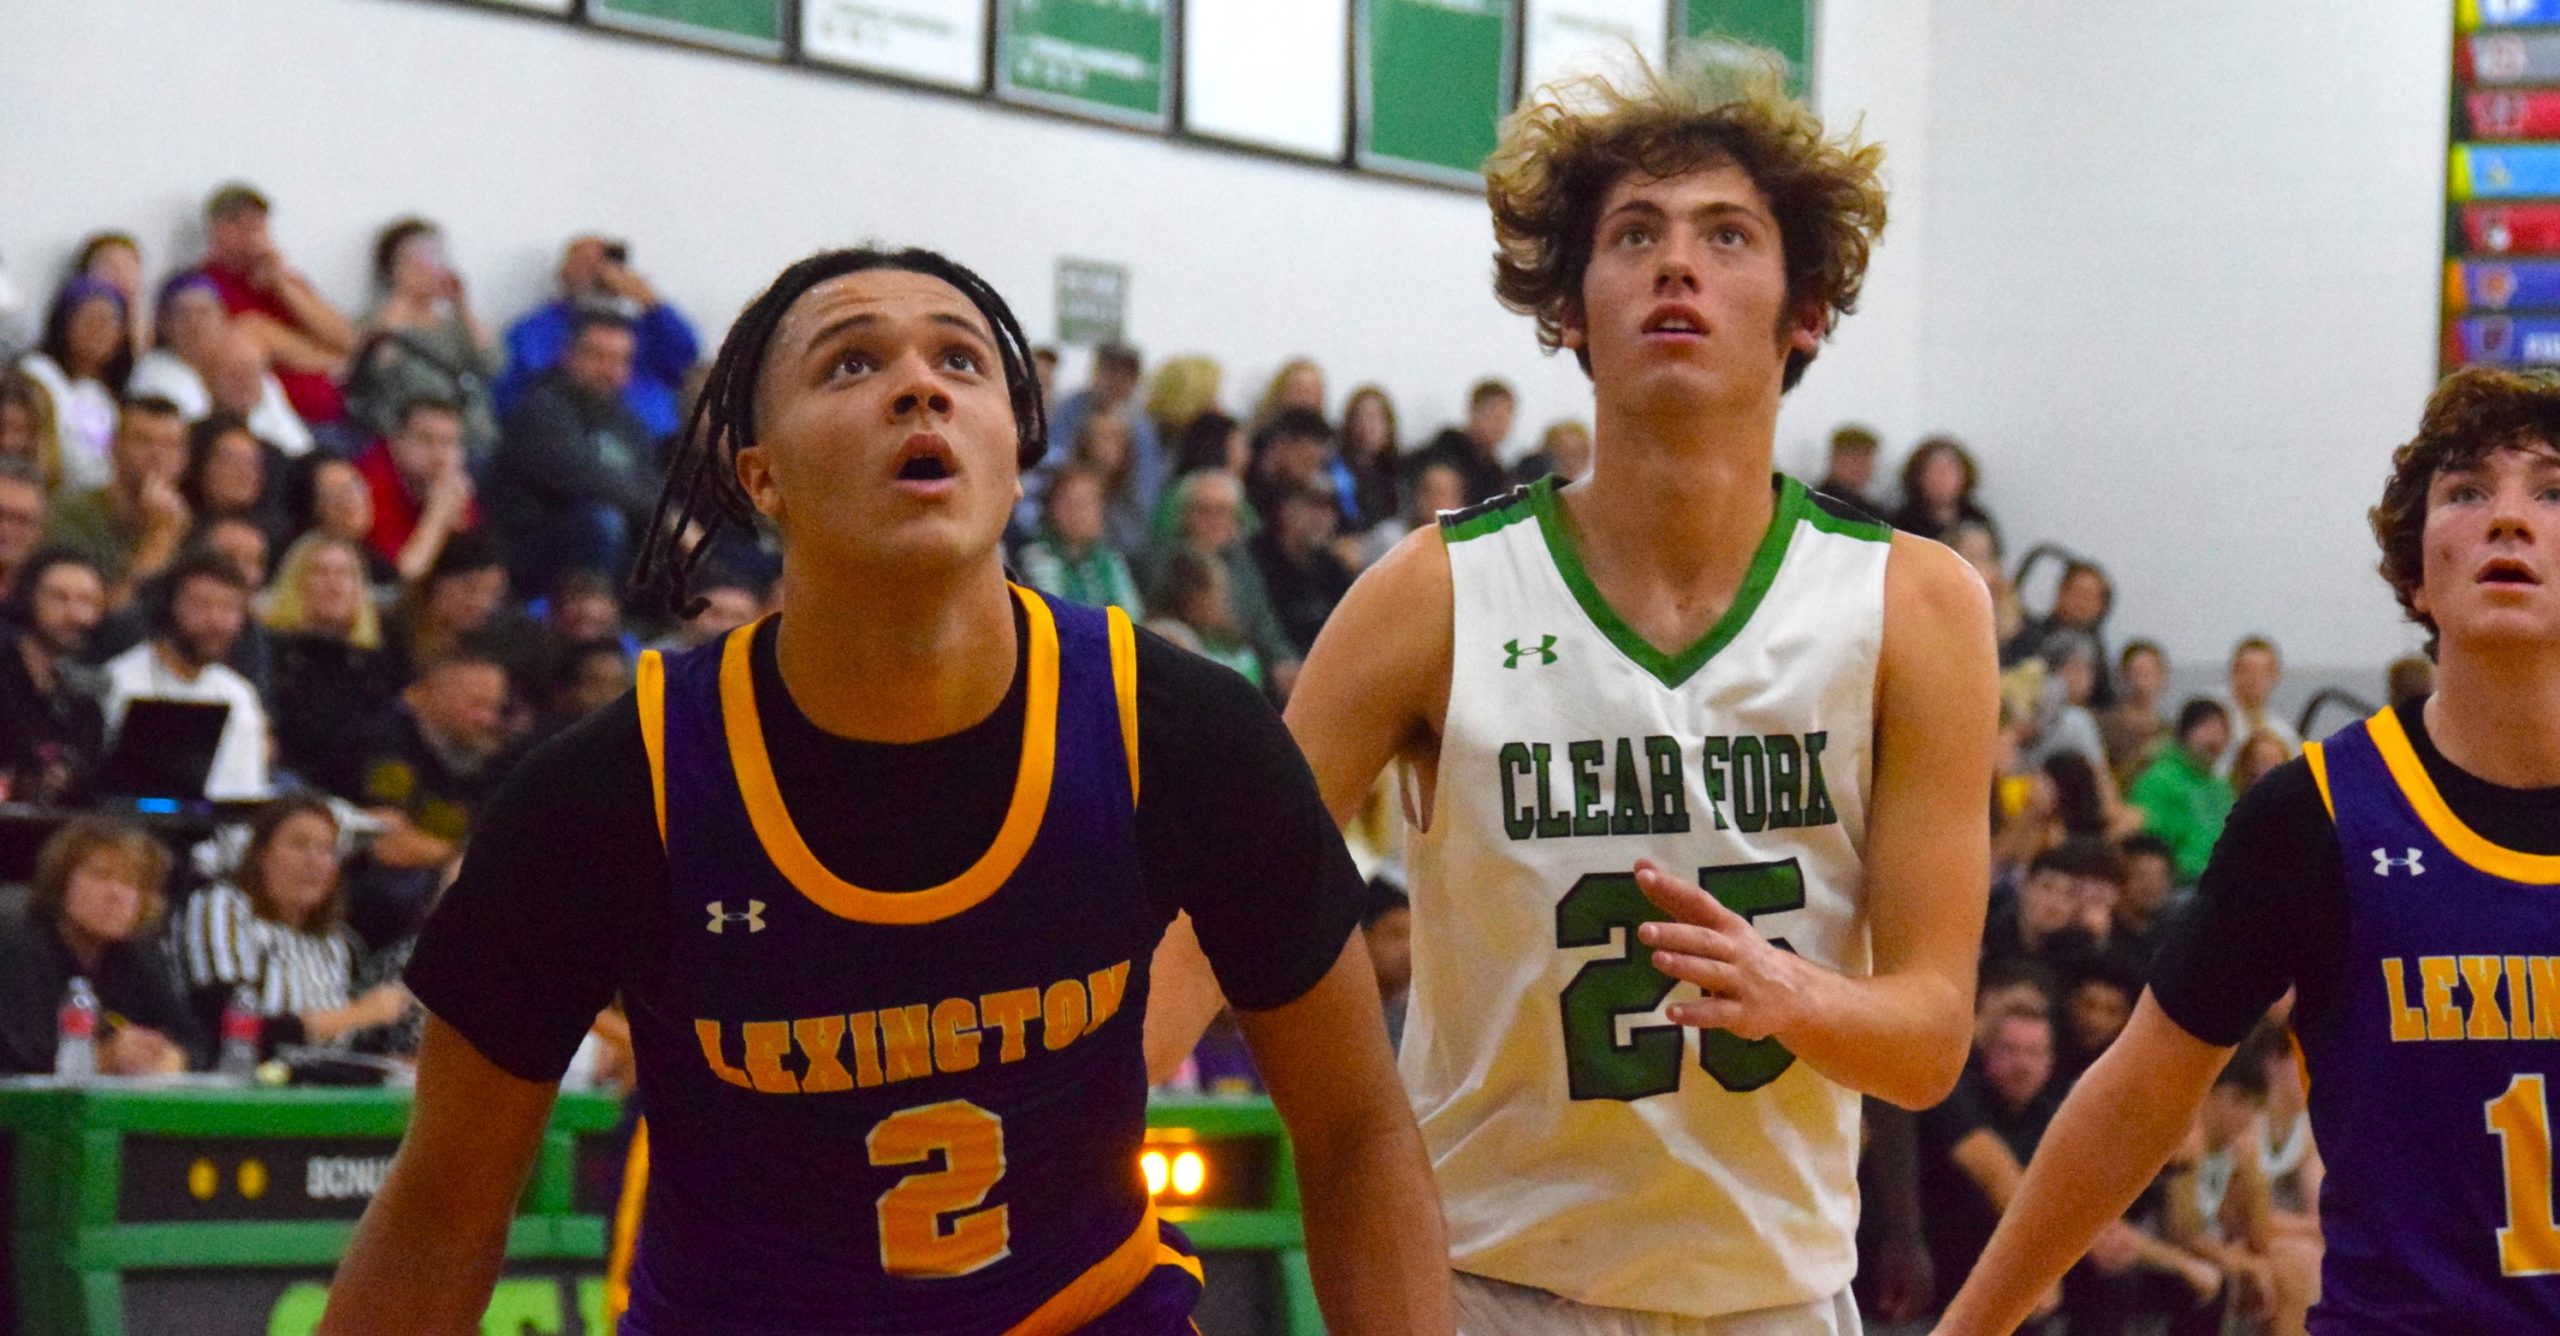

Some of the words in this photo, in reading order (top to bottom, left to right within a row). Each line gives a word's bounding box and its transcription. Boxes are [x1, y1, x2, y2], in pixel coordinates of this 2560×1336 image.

[1499, 735, 1690, 841] CLEAR
[1703, 730, 1838, 833] FORK
[695, 959, 1131, 1093] LEXINGTON
[306, 1155, 391, 1199] BONU
[866, 1098, 1011, 1278] 2
